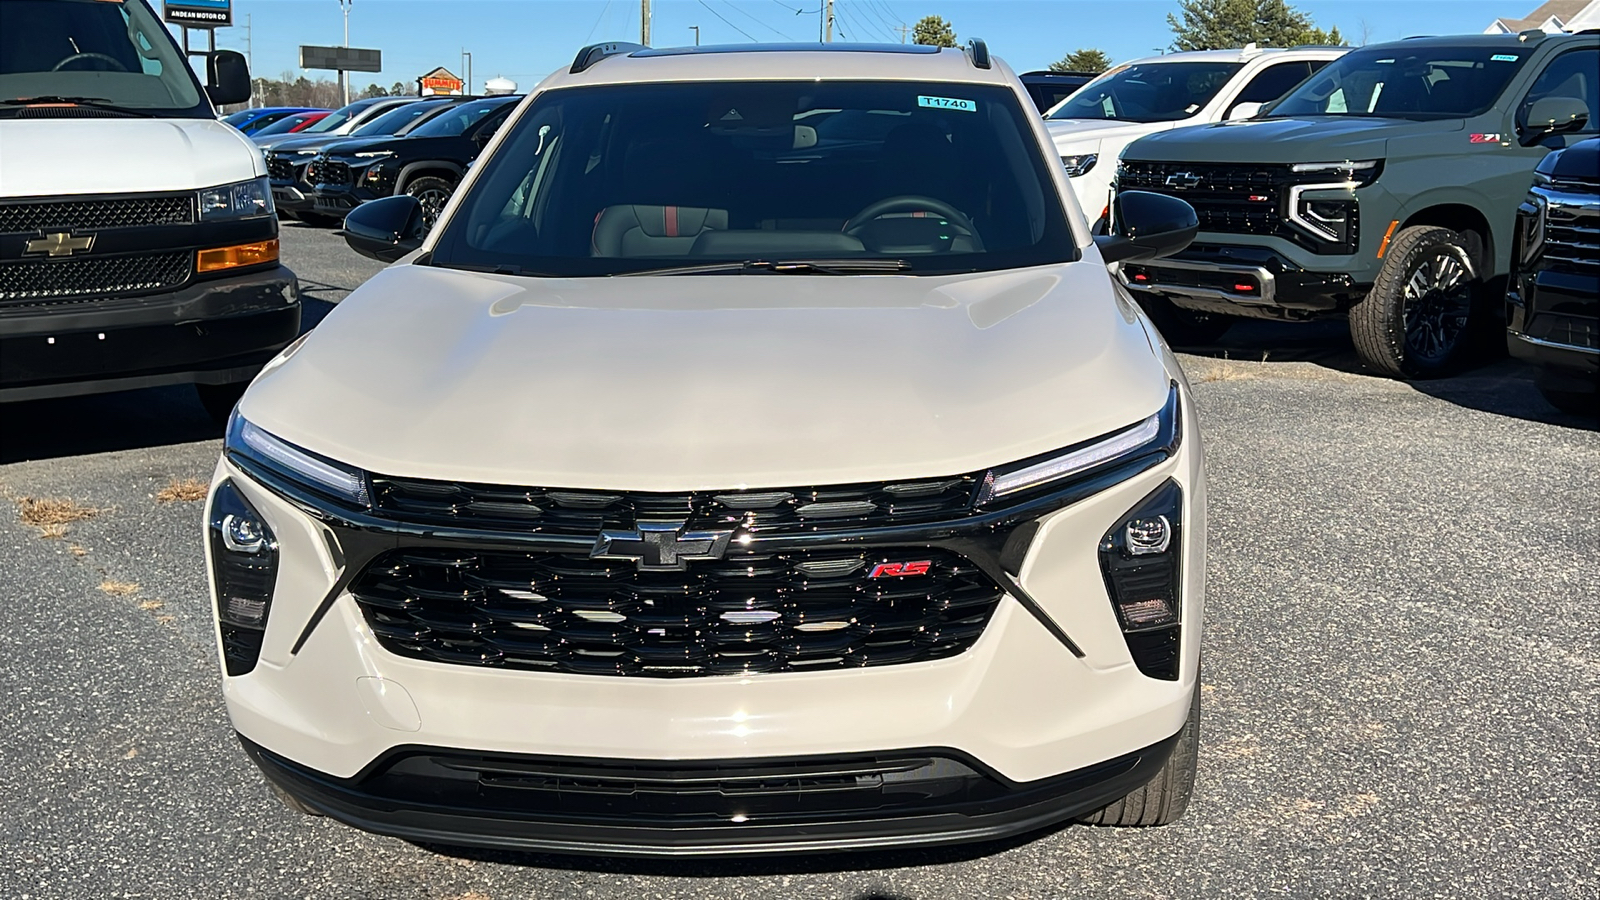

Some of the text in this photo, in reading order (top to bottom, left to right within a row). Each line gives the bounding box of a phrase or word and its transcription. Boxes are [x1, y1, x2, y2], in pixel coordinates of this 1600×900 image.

[171, 10, 196, 18] ANDEAN
[196, 12, 217, 20] MOTOR
[423, 78, 461, 90] SUMMITS
[923, 97, 968, 109] T1740
[1469, 133, 1501, 143] Z71
[867, 560, 932, 578] RS
